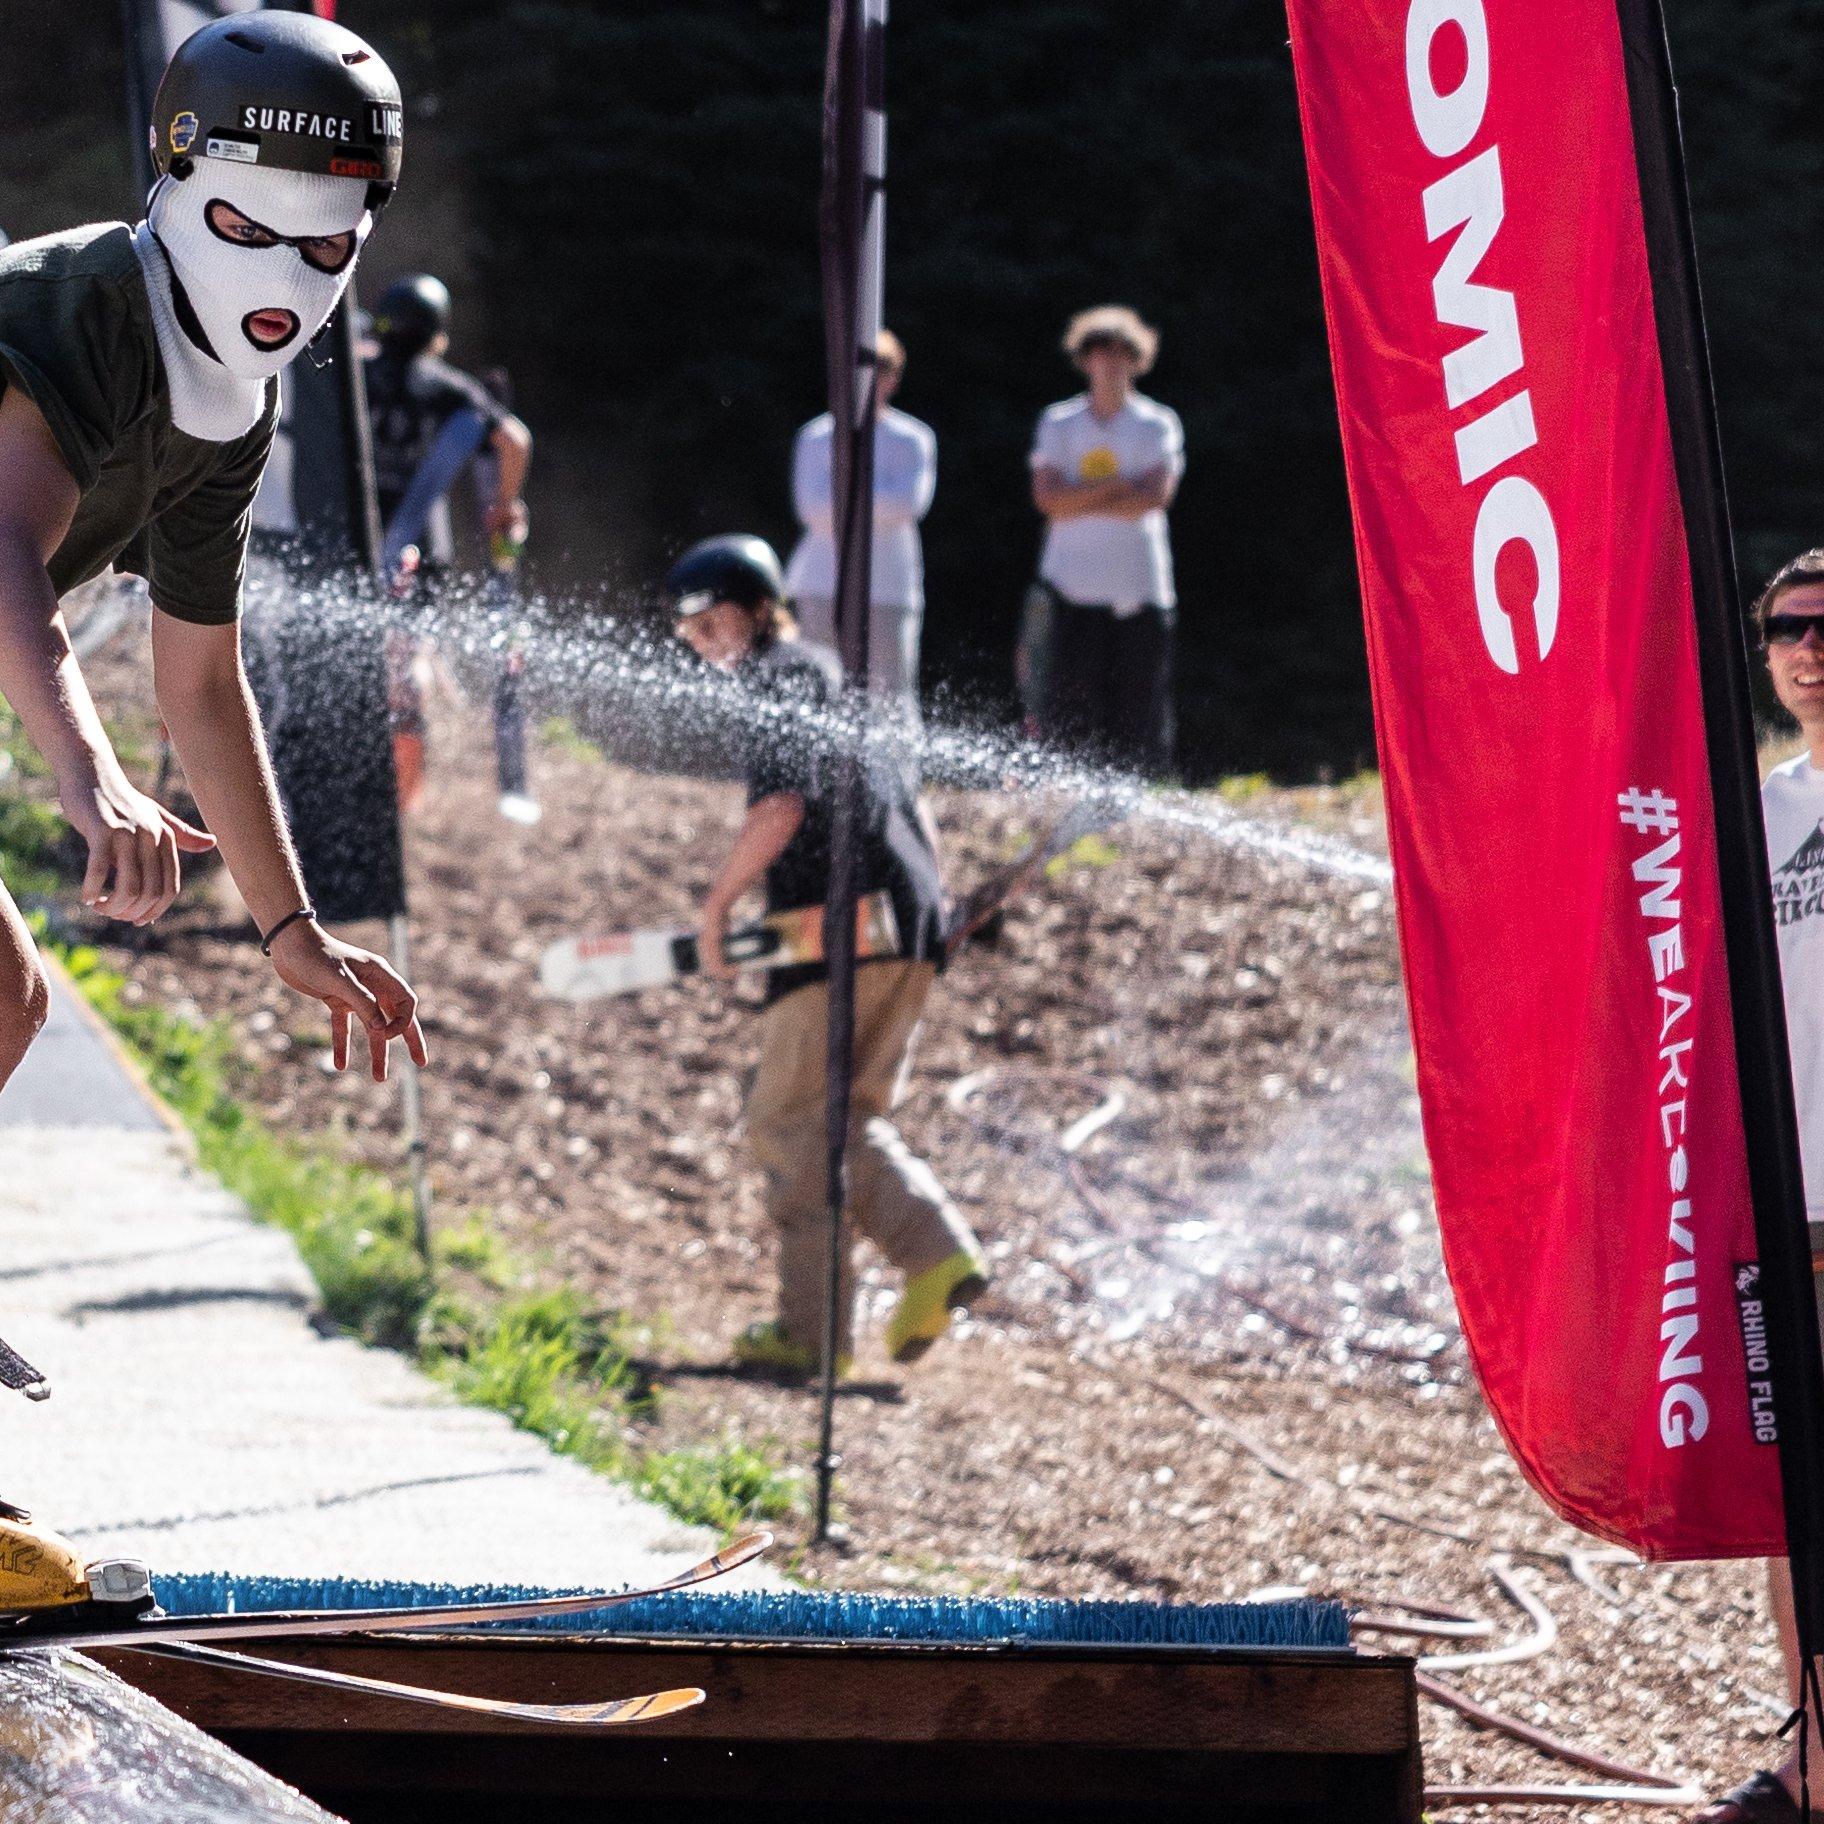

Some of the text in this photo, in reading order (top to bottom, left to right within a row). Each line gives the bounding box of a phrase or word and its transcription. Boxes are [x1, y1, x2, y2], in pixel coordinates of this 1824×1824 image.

[244, 107, 351, 142] SURFACE
[1741, 1299, 1779, 1444] RHINO FLAG
